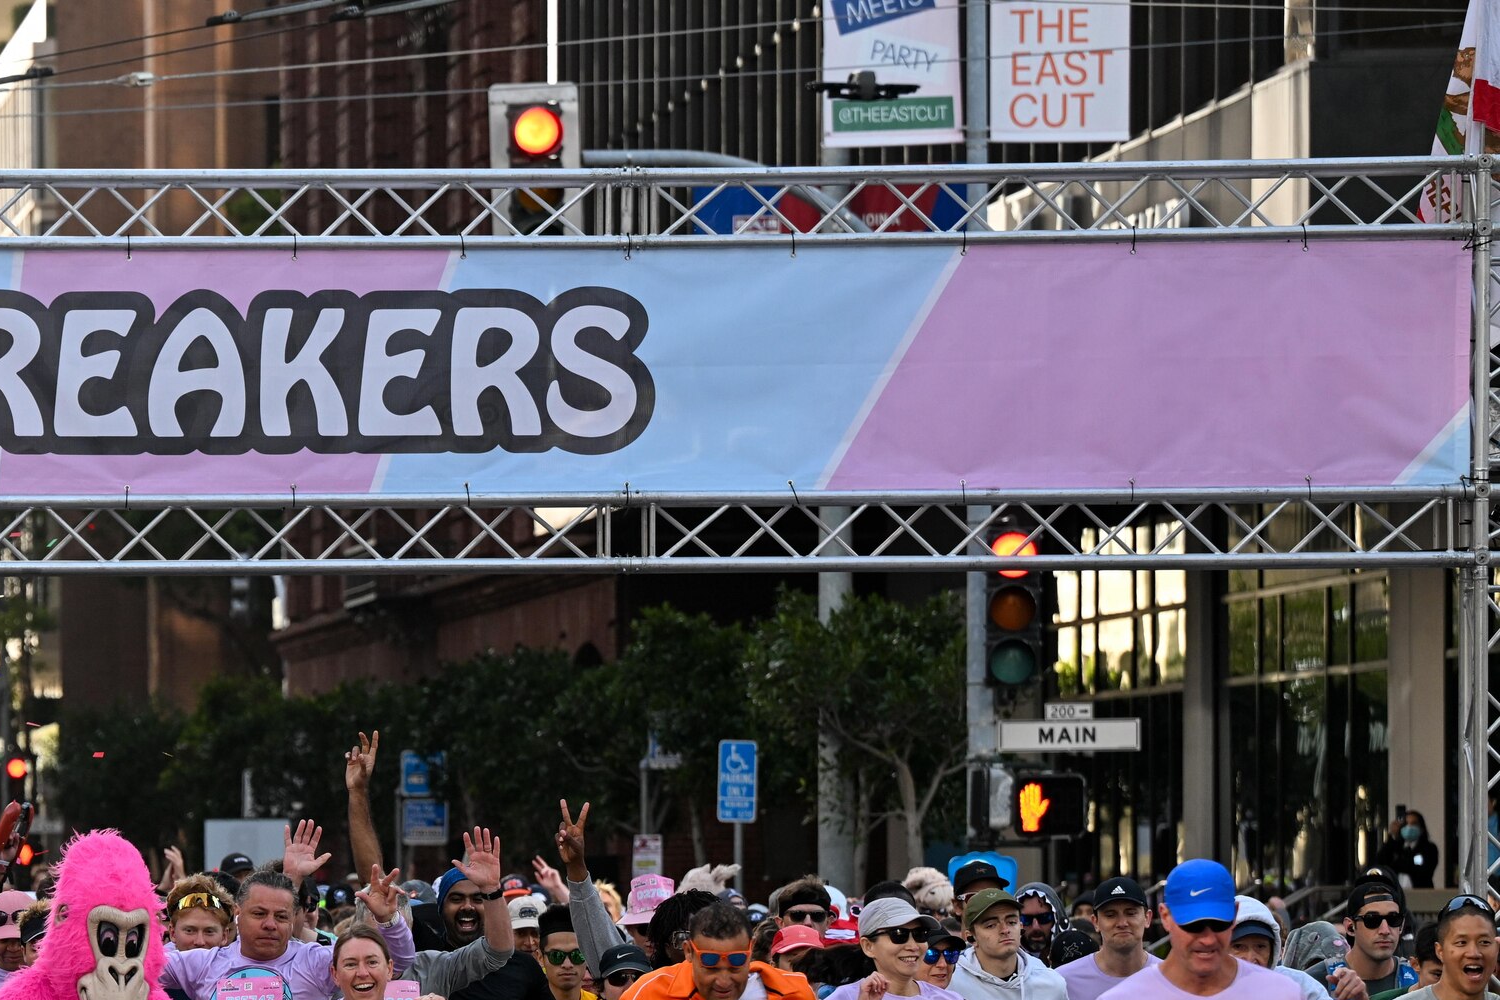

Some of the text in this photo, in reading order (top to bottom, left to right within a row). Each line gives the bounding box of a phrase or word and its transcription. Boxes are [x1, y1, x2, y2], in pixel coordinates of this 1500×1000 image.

[1010, 8, 1089, 44] THE
[871, 39, 939, 73] PARTY
[1011, 50, 1113, 87] EAST
[838, 105, 948, 125] @THEEASTCUT
[1009, 92, 1095, 129] CUT
[1050, 706, 1075, 718] 200
[1038, 727, 1097, 744] MAIN
